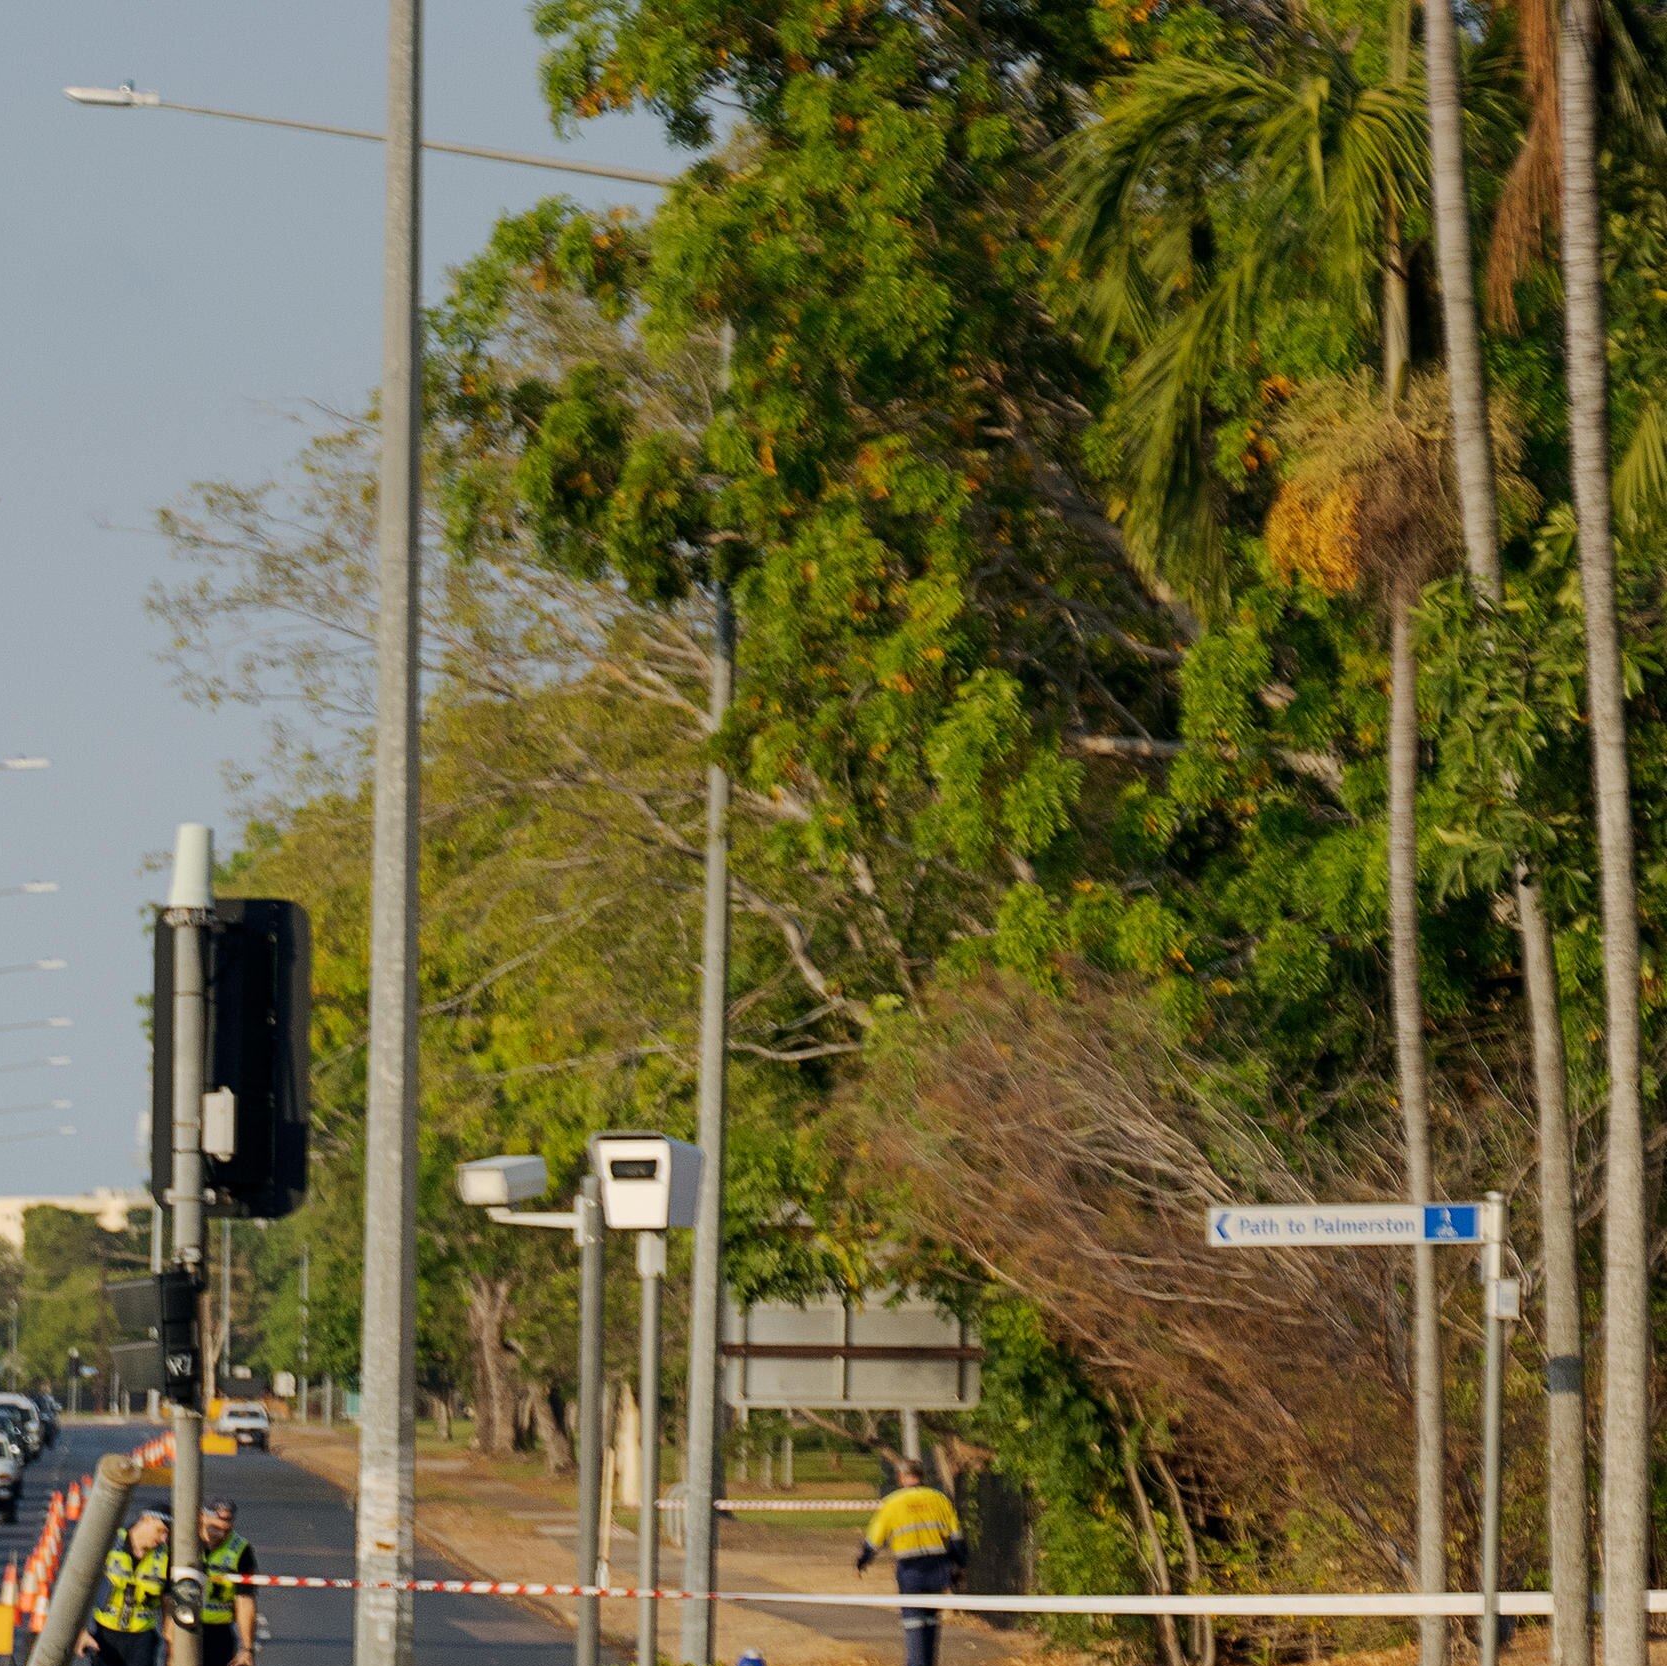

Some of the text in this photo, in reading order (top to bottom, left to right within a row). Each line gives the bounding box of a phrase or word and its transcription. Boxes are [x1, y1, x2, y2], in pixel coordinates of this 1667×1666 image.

[1240, 1216, 1415, 1235] Path to Palmerston
